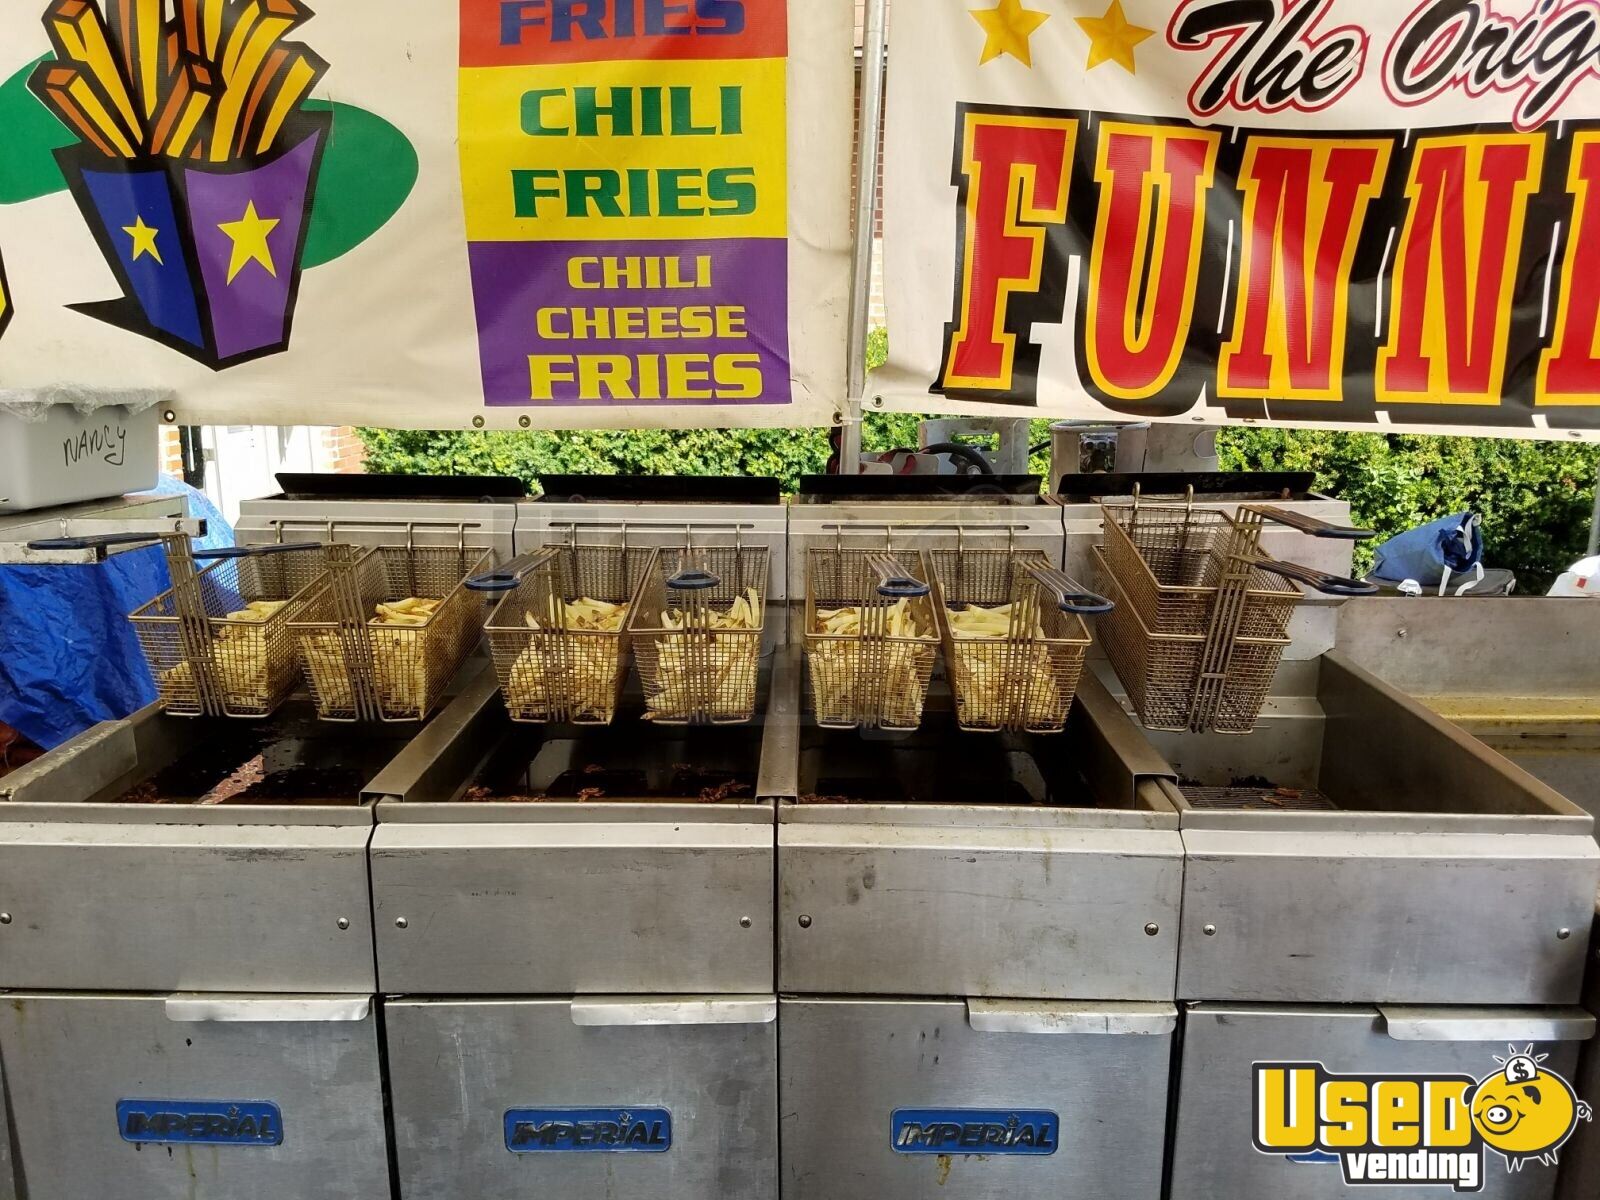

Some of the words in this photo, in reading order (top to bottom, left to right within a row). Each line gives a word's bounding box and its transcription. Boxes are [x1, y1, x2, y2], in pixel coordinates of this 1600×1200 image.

[499, 0, 745, 46] FRIES
[1174, 0, 1360, 112] The
[1391, 0, 1600, 121] Orig
[519, 85, 743, 137] CHILI
[510, 166, 757, 219] FRIES
[566, 255, 712, 290] CHILI
[535, 304, 748, 340] CHEESE
[527, 352, 764, 400] FRIES
[125, 1107, 275, 1140] IMPERIAL
[509, 1113, 667, 1146] IMPERIAL
[896, 1114, 1054, 1147] IMPERIAL
